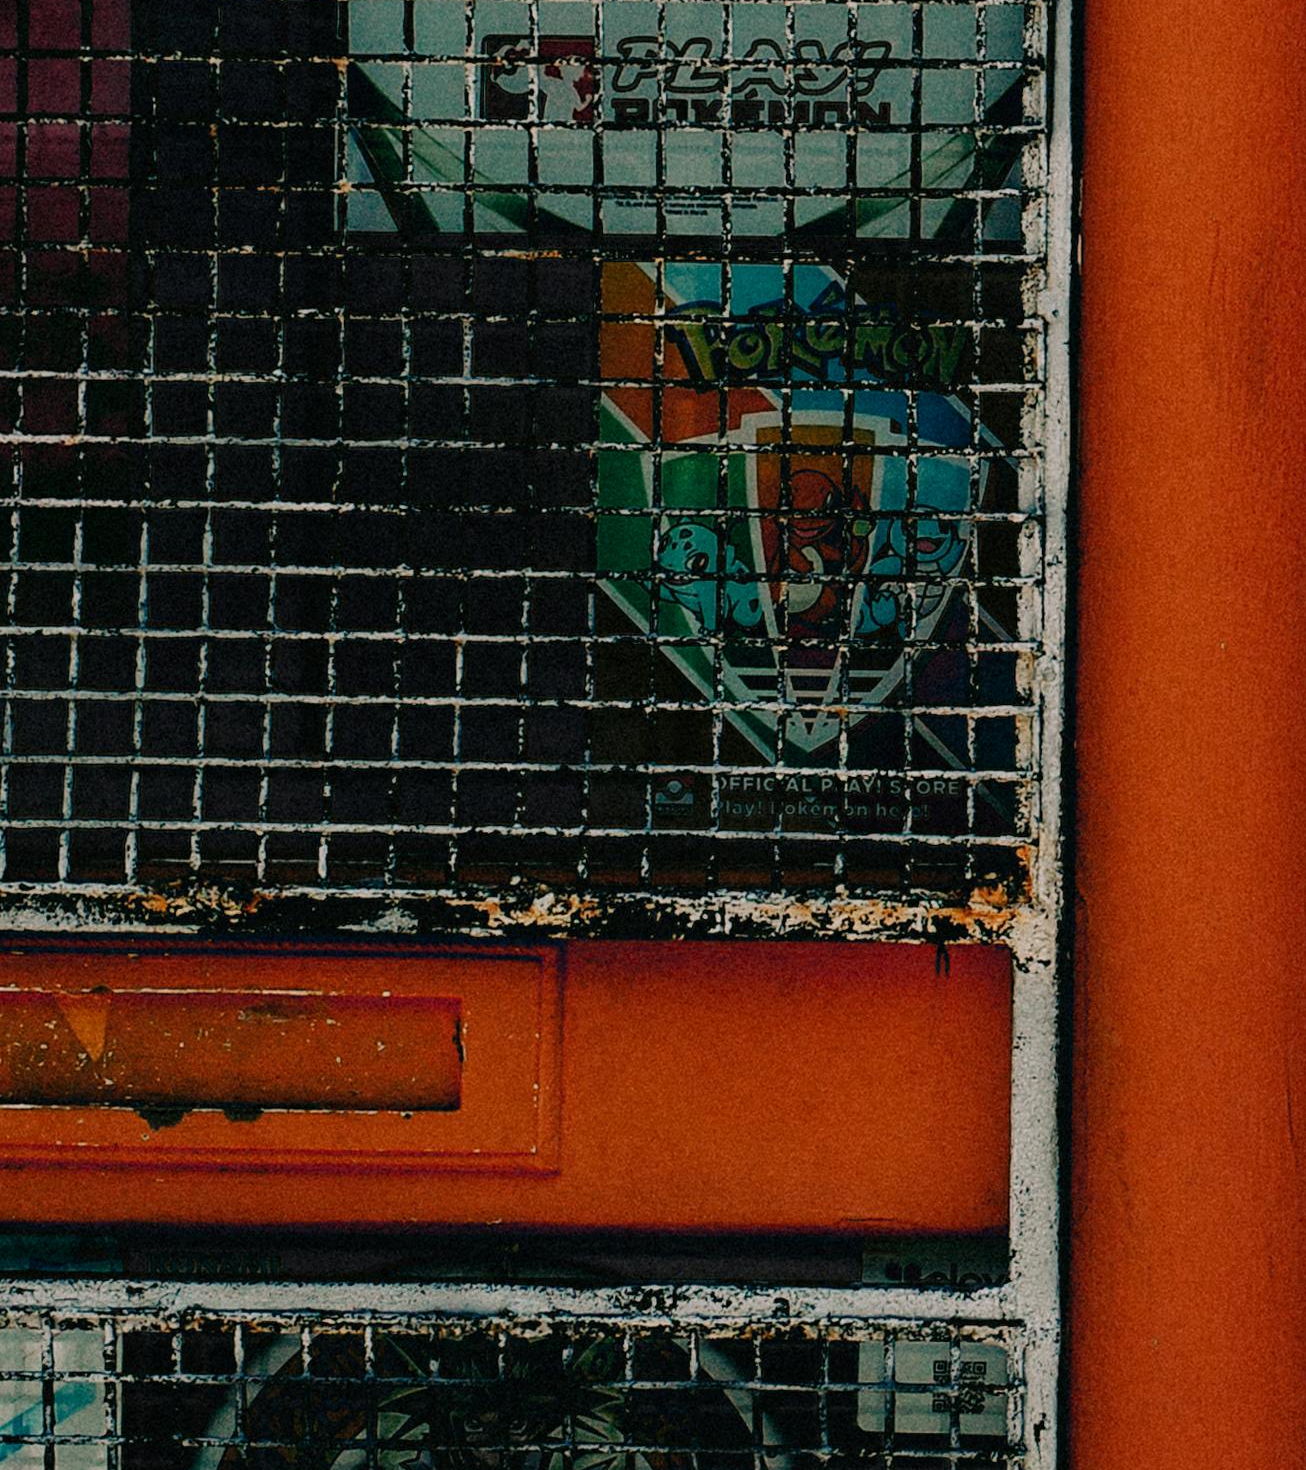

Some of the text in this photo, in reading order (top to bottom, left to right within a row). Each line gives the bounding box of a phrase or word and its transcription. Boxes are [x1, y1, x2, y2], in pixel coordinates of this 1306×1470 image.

[612, 36, 892, 97] PLAY!
[712, 775, 961, 796] OFFICAL PAY! SORE
[876, 800, 929, 819] hee!
